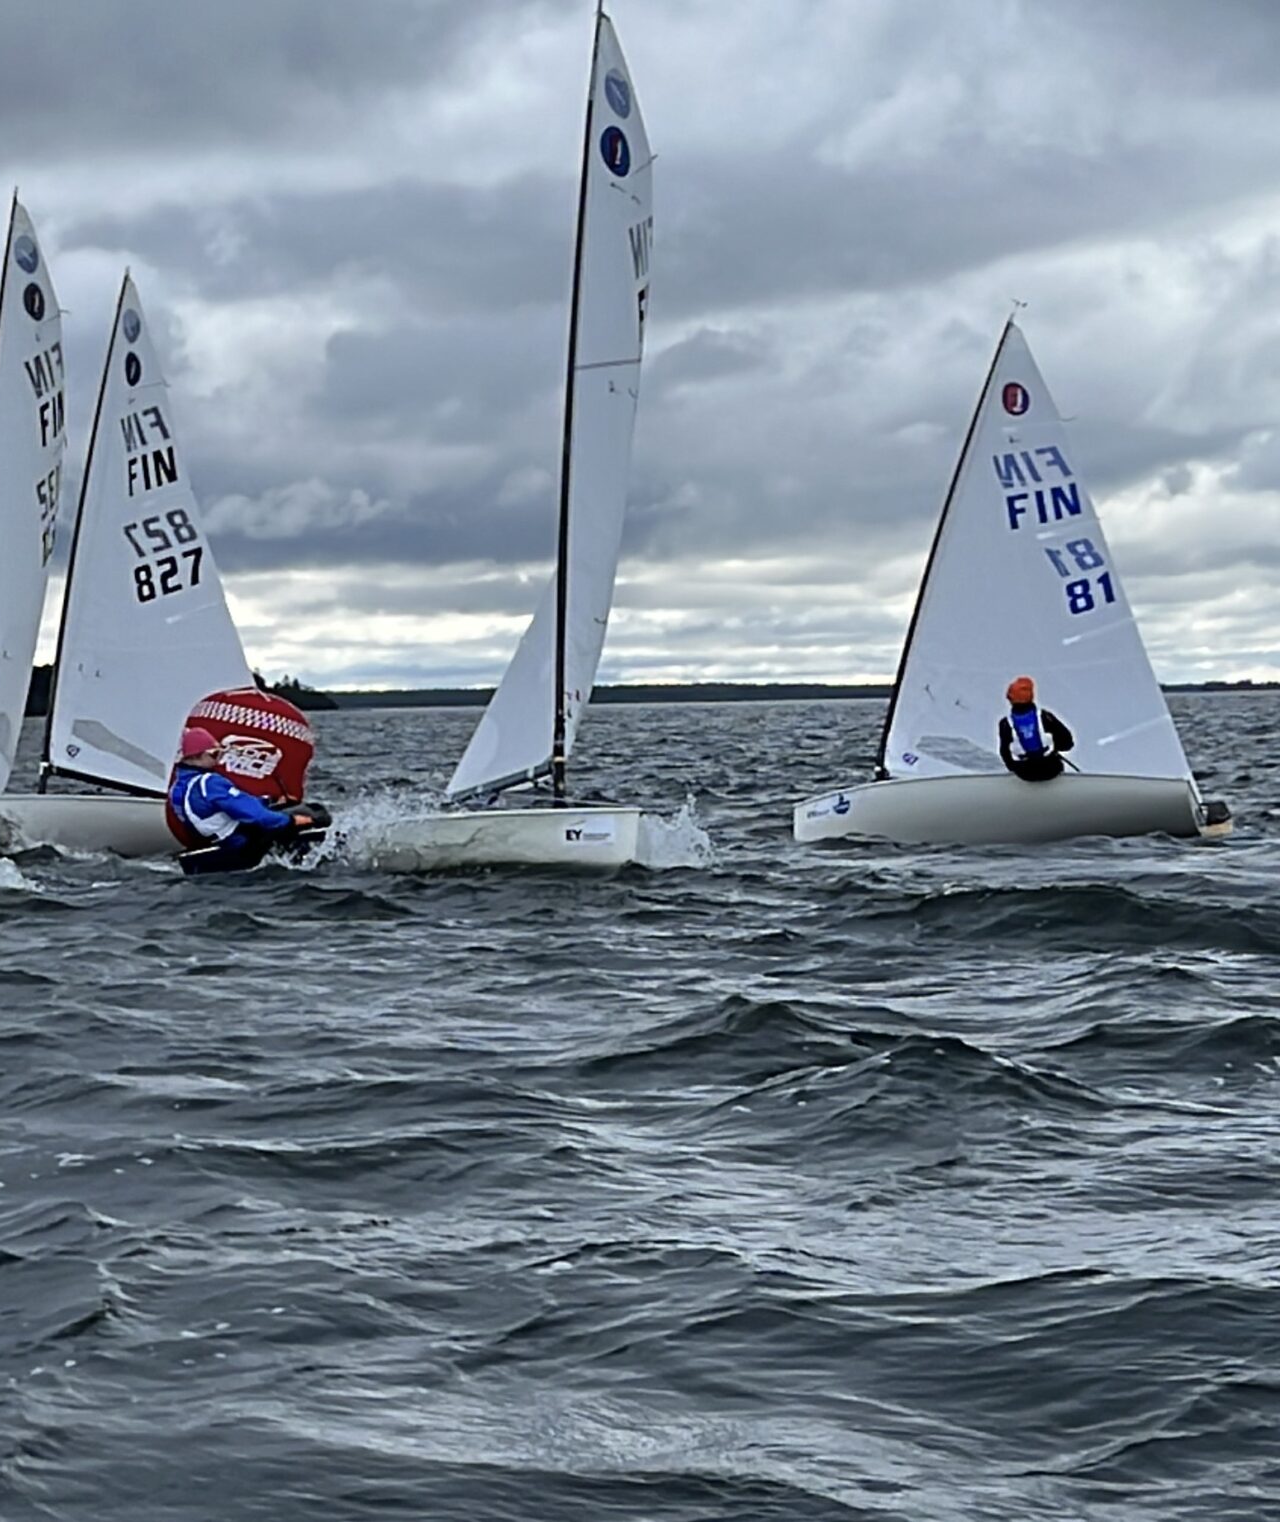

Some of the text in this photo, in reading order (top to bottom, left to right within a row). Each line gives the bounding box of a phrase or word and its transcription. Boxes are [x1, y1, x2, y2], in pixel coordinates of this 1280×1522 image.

[128, 446, 178, 497] FIN
[1006, 483, 1082, 530] FIN
[134, 547, 203, 602] 827
[1065, 571, 1116, 615] 81
[566, 829, 583, 841] EY
